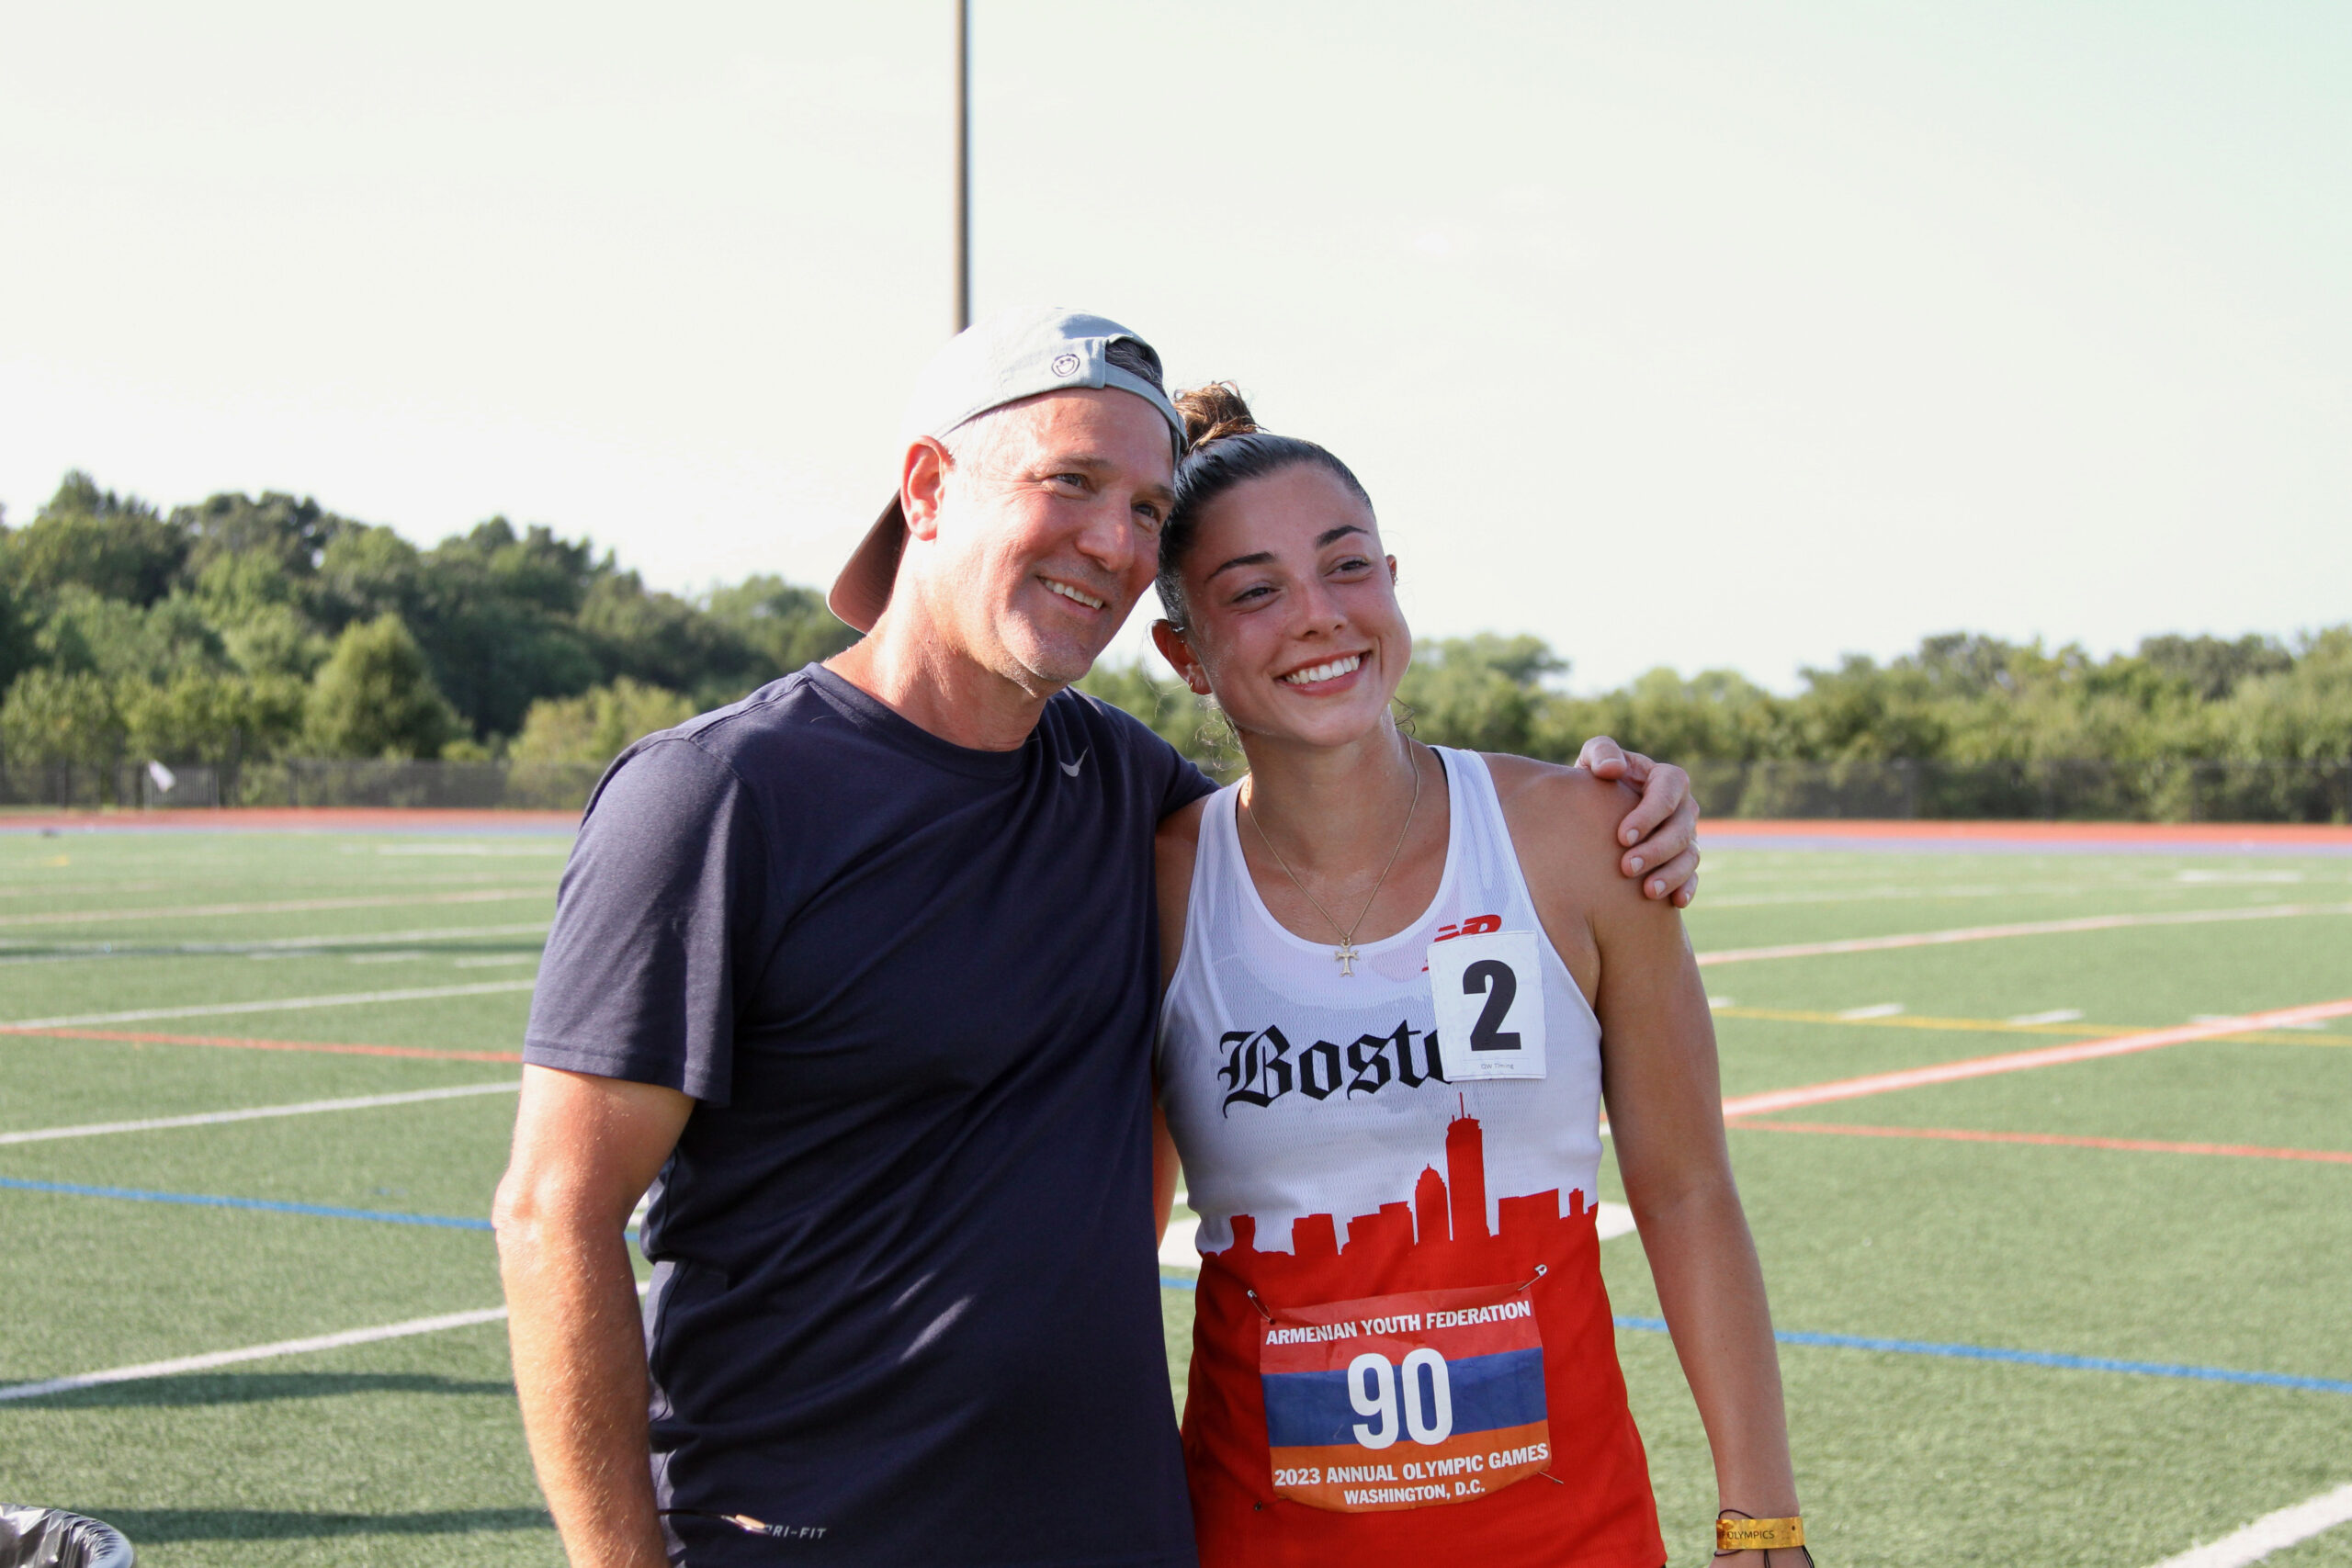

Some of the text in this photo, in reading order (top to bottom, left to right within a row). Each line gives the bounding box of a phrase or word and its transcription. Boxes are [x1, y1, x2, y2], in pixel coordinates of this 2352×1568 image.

[1463, 959, 1521, 1051] 2
[1217, 1019, 1452, 1119] Bost
[1266, 1301, 1532, 1346] ARMENIAN YOUTH FEDERATION
[1348, 1348, 1453, 1450] 90
[1274, 1443, 1549, 1486] 2023 ANNUAL OLYMPIC GAMES
[1343, 1480, 1486, 1506] WASHINGTON, D.C.
[1727, 1530, 1774, 1540] OLYMPICS
